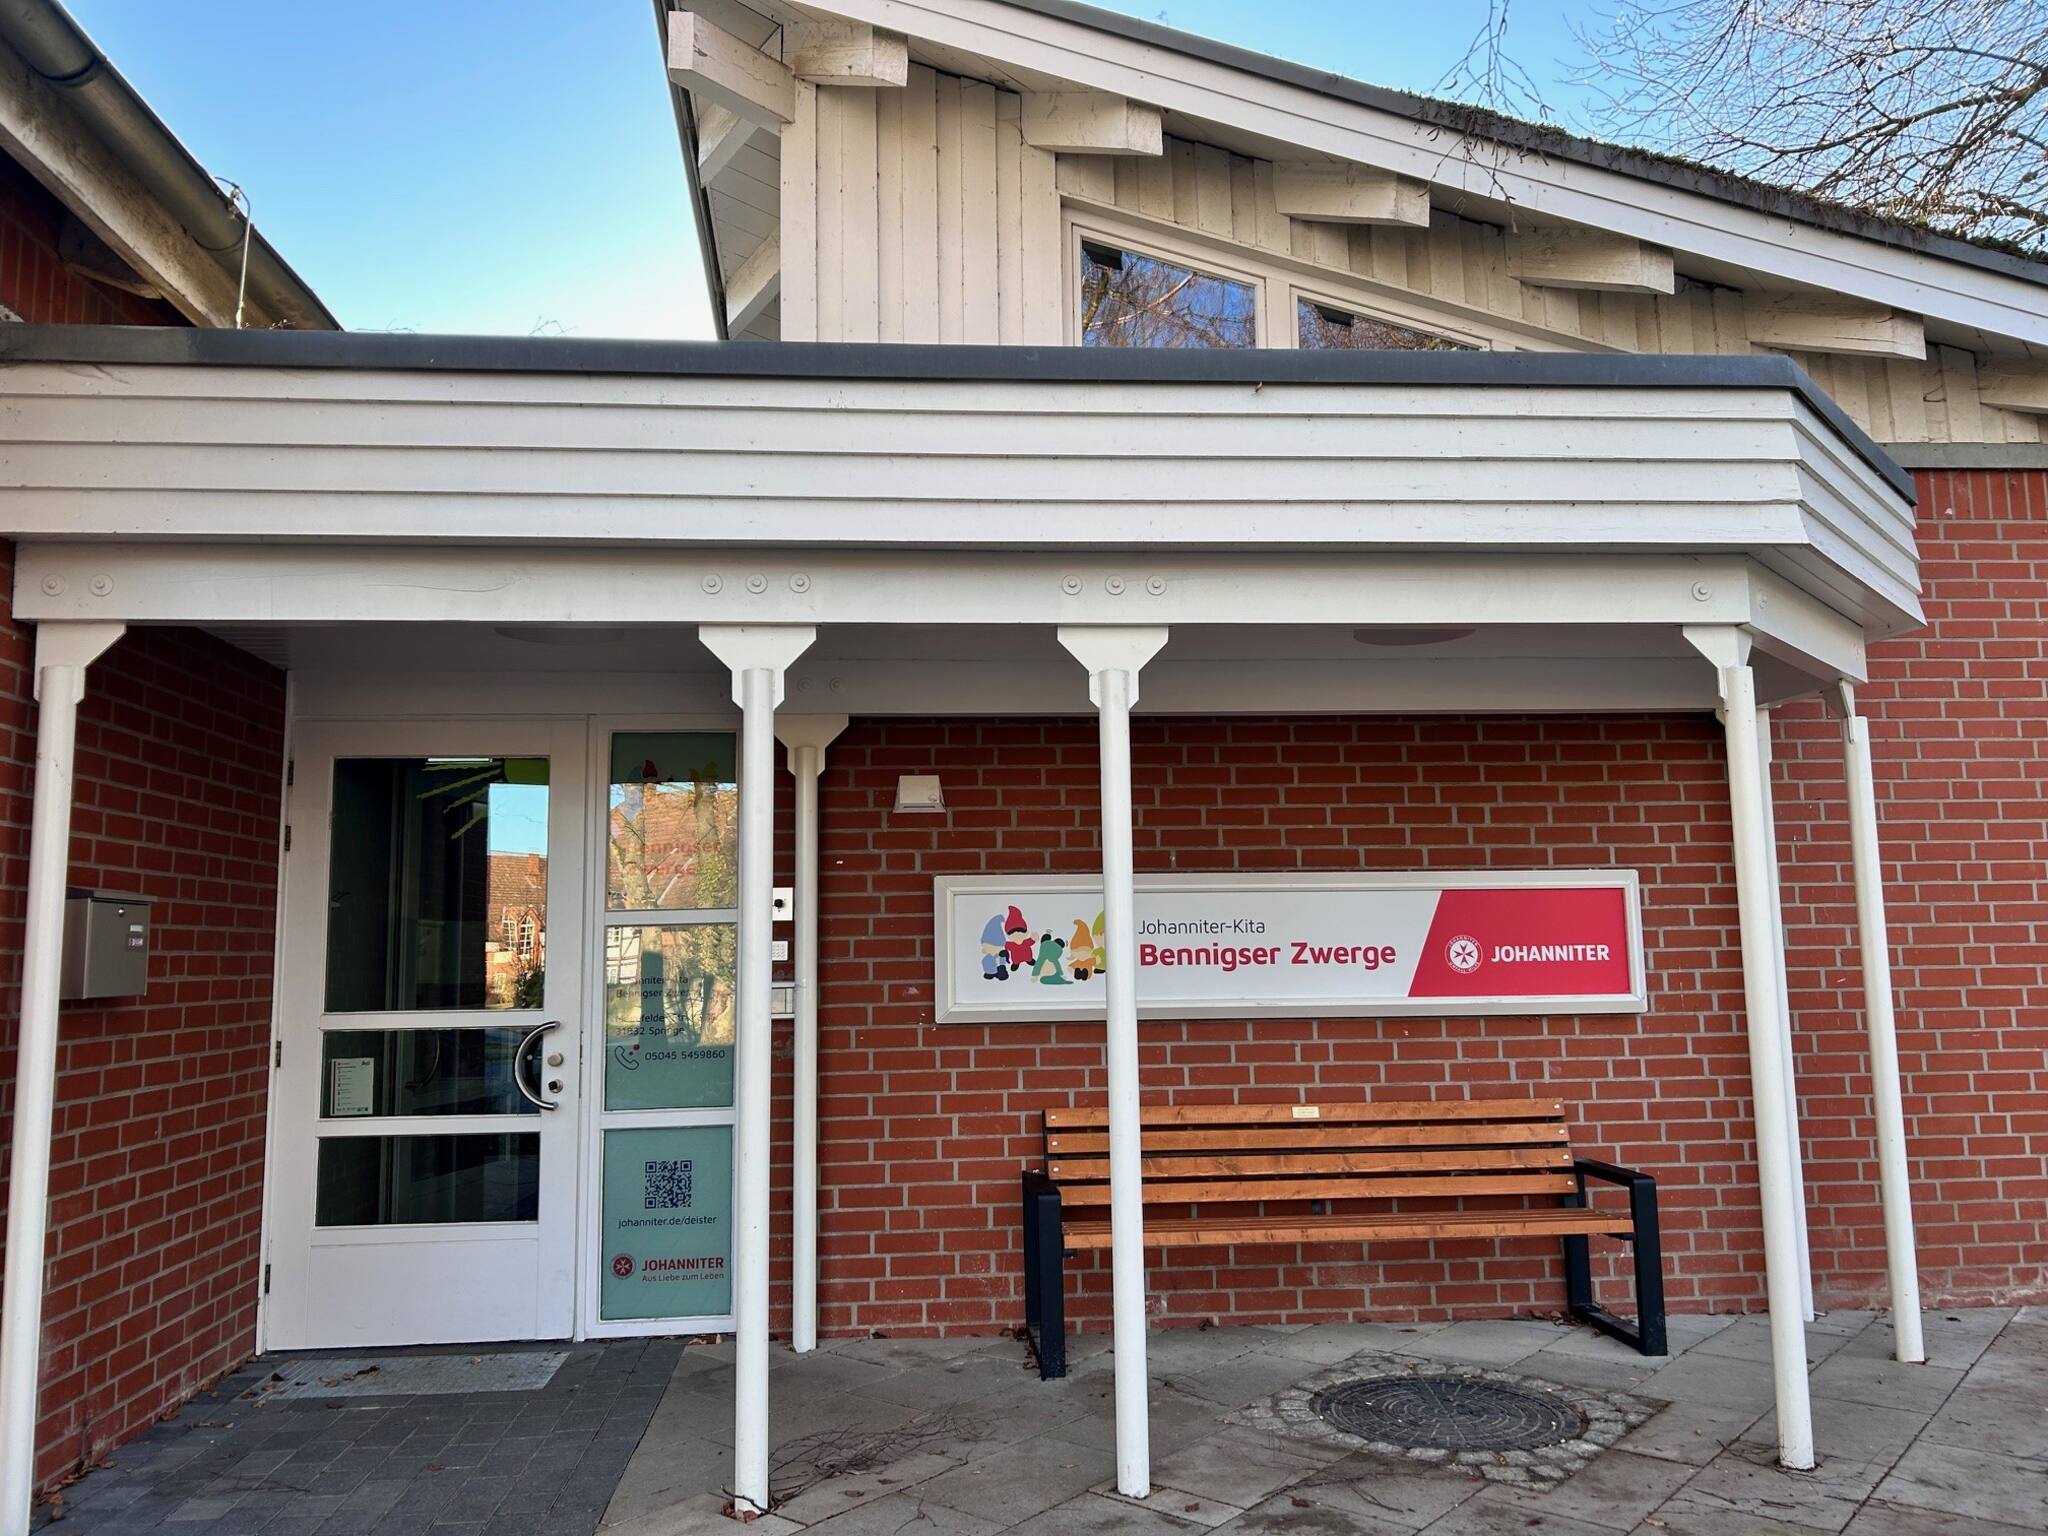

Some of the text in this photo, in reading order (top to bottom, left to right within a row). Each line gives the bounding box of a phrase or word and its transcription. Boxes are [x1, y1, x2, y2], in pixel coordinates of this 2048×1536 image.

[1138, 918, 1266, 935] Johanniter-Kita
[1140, 942, 1397, 972] Bennigser Zwerge
[1491, 944, 1610, 962] JOHANNITER
[644, 1049, 726, 1061] 05045 5459860
[618, 1215, 718, 1229] johanniter.de/deister
[641, 1257, 724, 1272] JOHANNITER
[658, 1273, 679, 1282] Liebe
[700, 1271, 724, 1281] Leben
